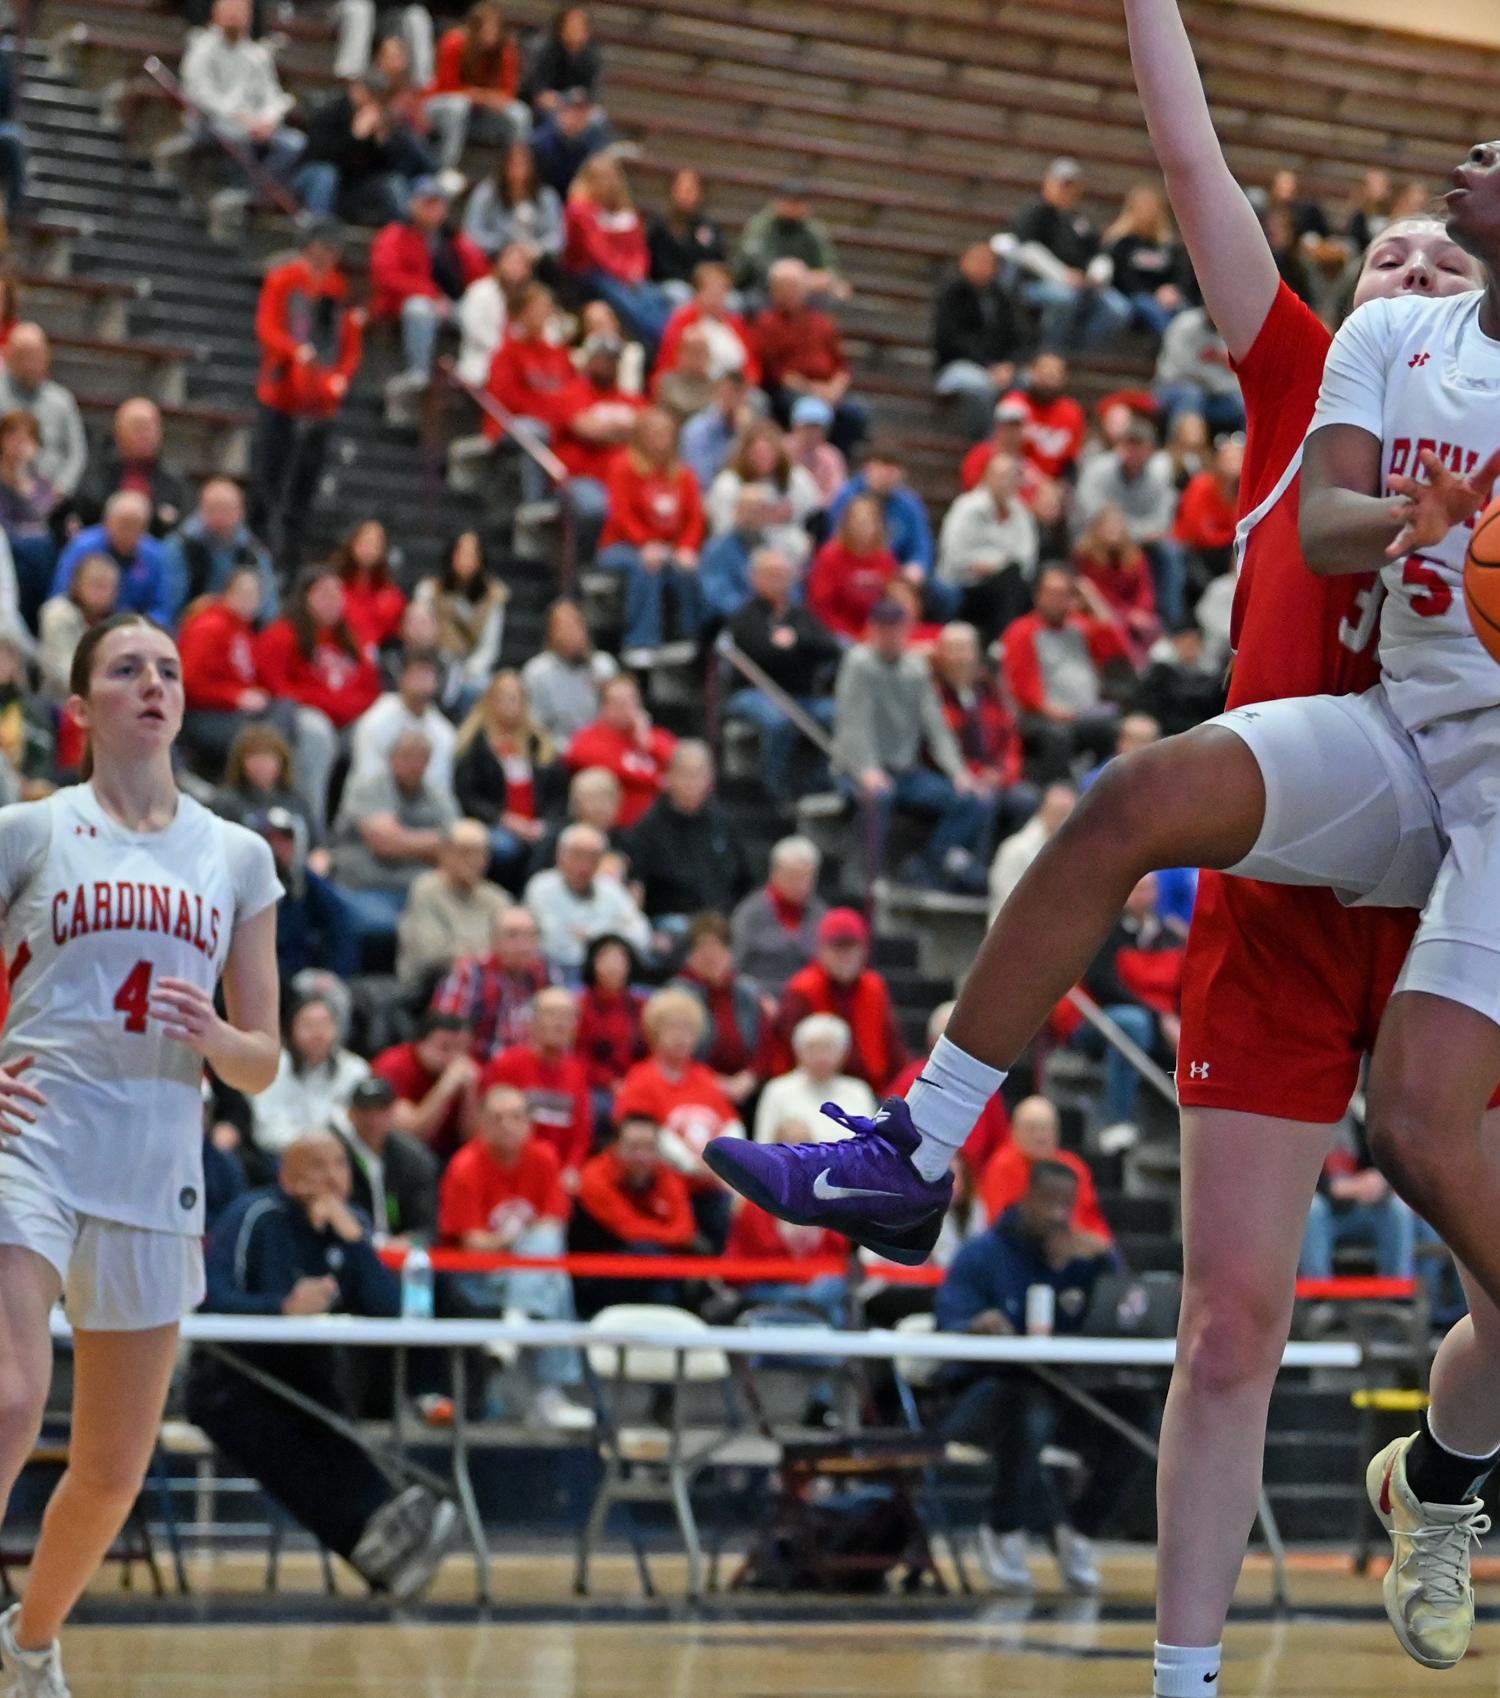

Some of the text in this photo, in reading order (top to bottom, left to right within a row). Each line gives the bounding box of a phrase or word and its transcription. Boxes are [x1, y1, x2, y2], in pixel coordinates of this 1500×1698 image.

[1402, 553, 1454, 618] 5
[52, 881, 222, 961] CARDINALS
[113, 960, 154, 1034] 4
